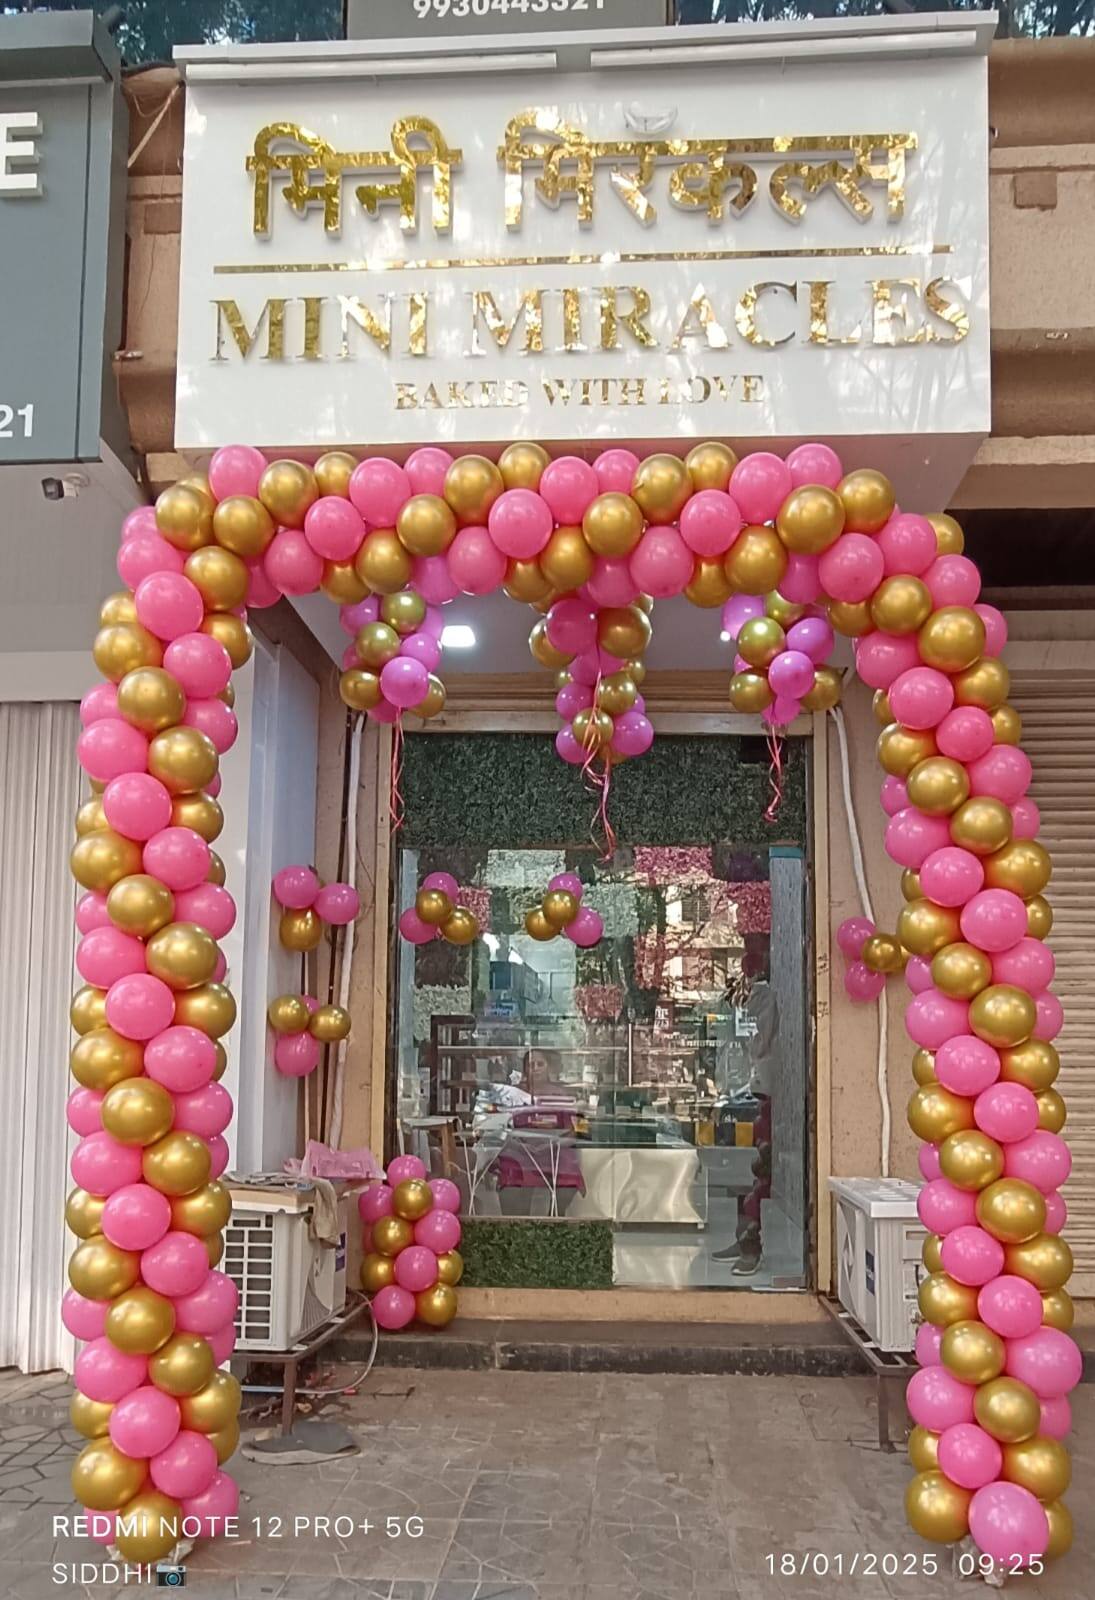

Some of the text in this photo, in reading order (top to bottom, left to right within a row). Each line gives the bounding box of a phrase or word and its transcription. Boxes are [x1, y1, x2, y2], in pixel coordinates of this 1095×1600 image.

[245, 114, 464, 240] मिनी
[209, 275, 973, 361] MINI MIRACLES
[0, 403, 34, 438] 21
[394, 374, 765, 410] BAKED WITH LOVE
